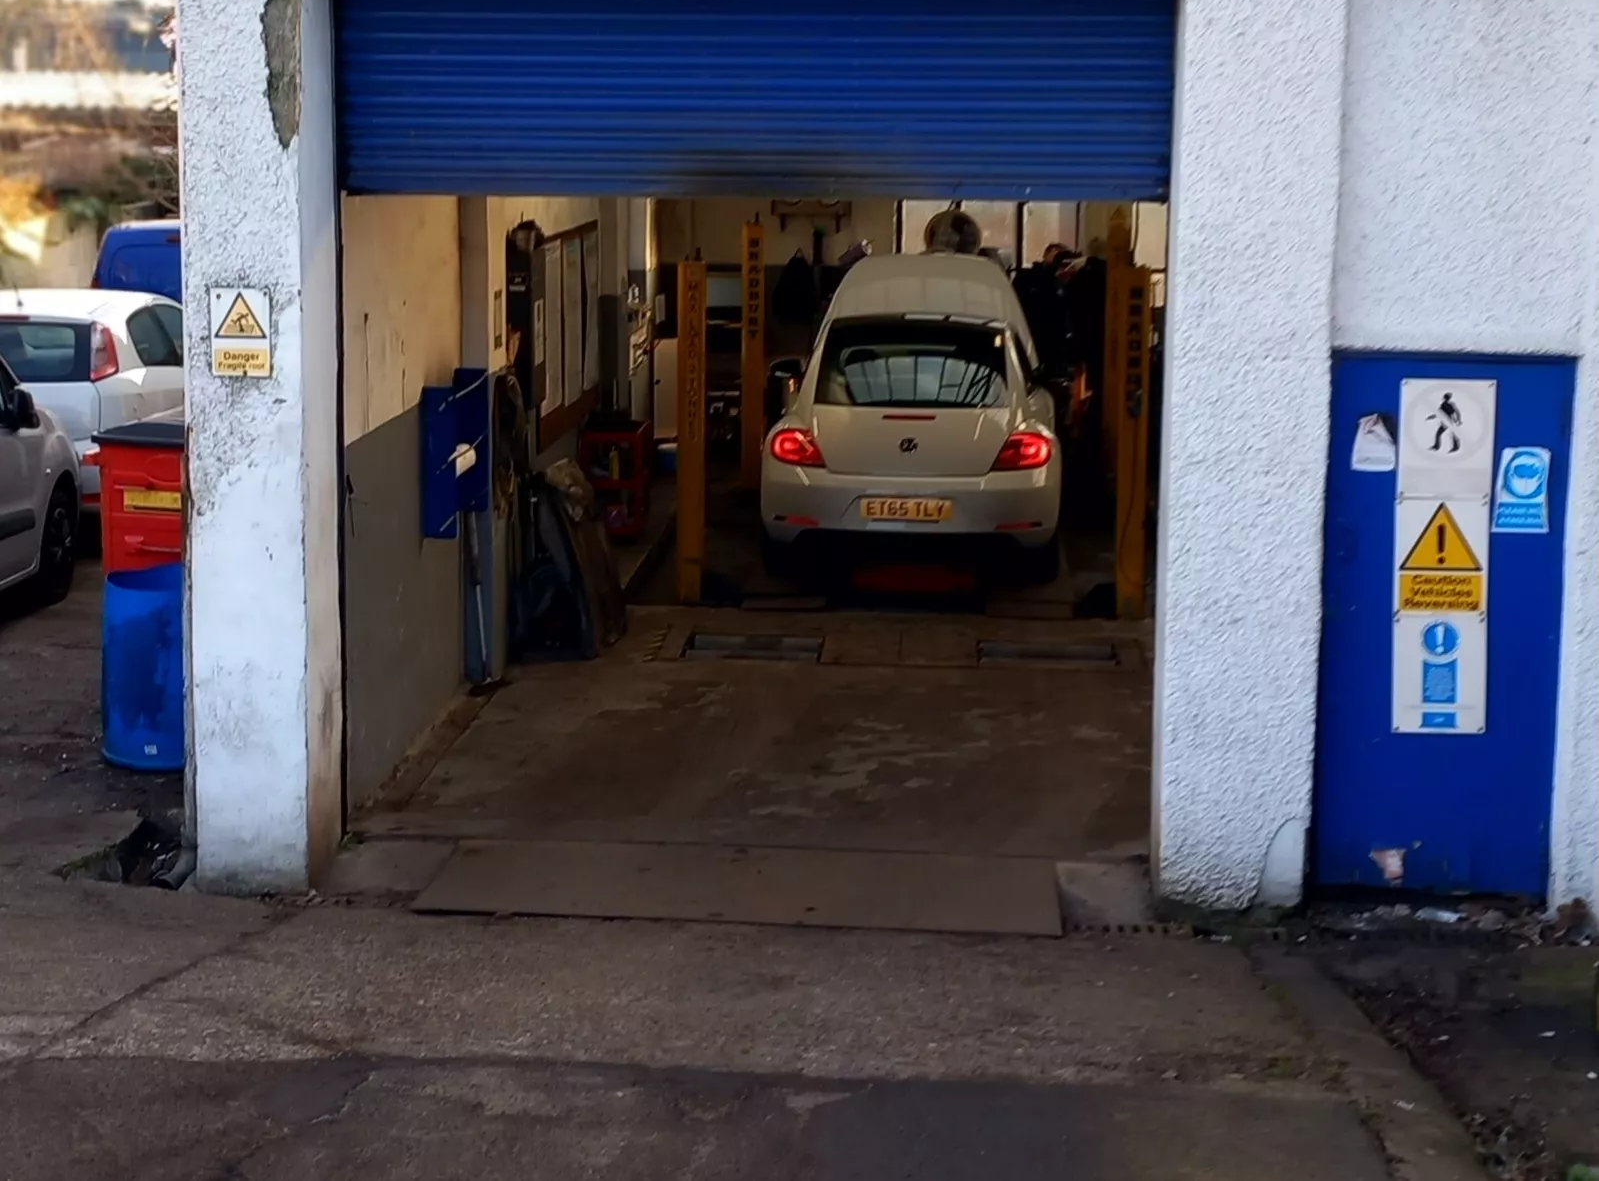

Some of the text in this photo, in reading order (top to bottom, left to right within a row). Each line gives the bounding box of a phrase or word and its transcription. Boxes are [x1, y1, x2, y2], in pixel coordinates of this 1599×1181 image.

[223, 351, 260, 362] Danger
[866, 501, 945, 517] ET65 TLY
[1411, 574, 1472, 586] Caution
